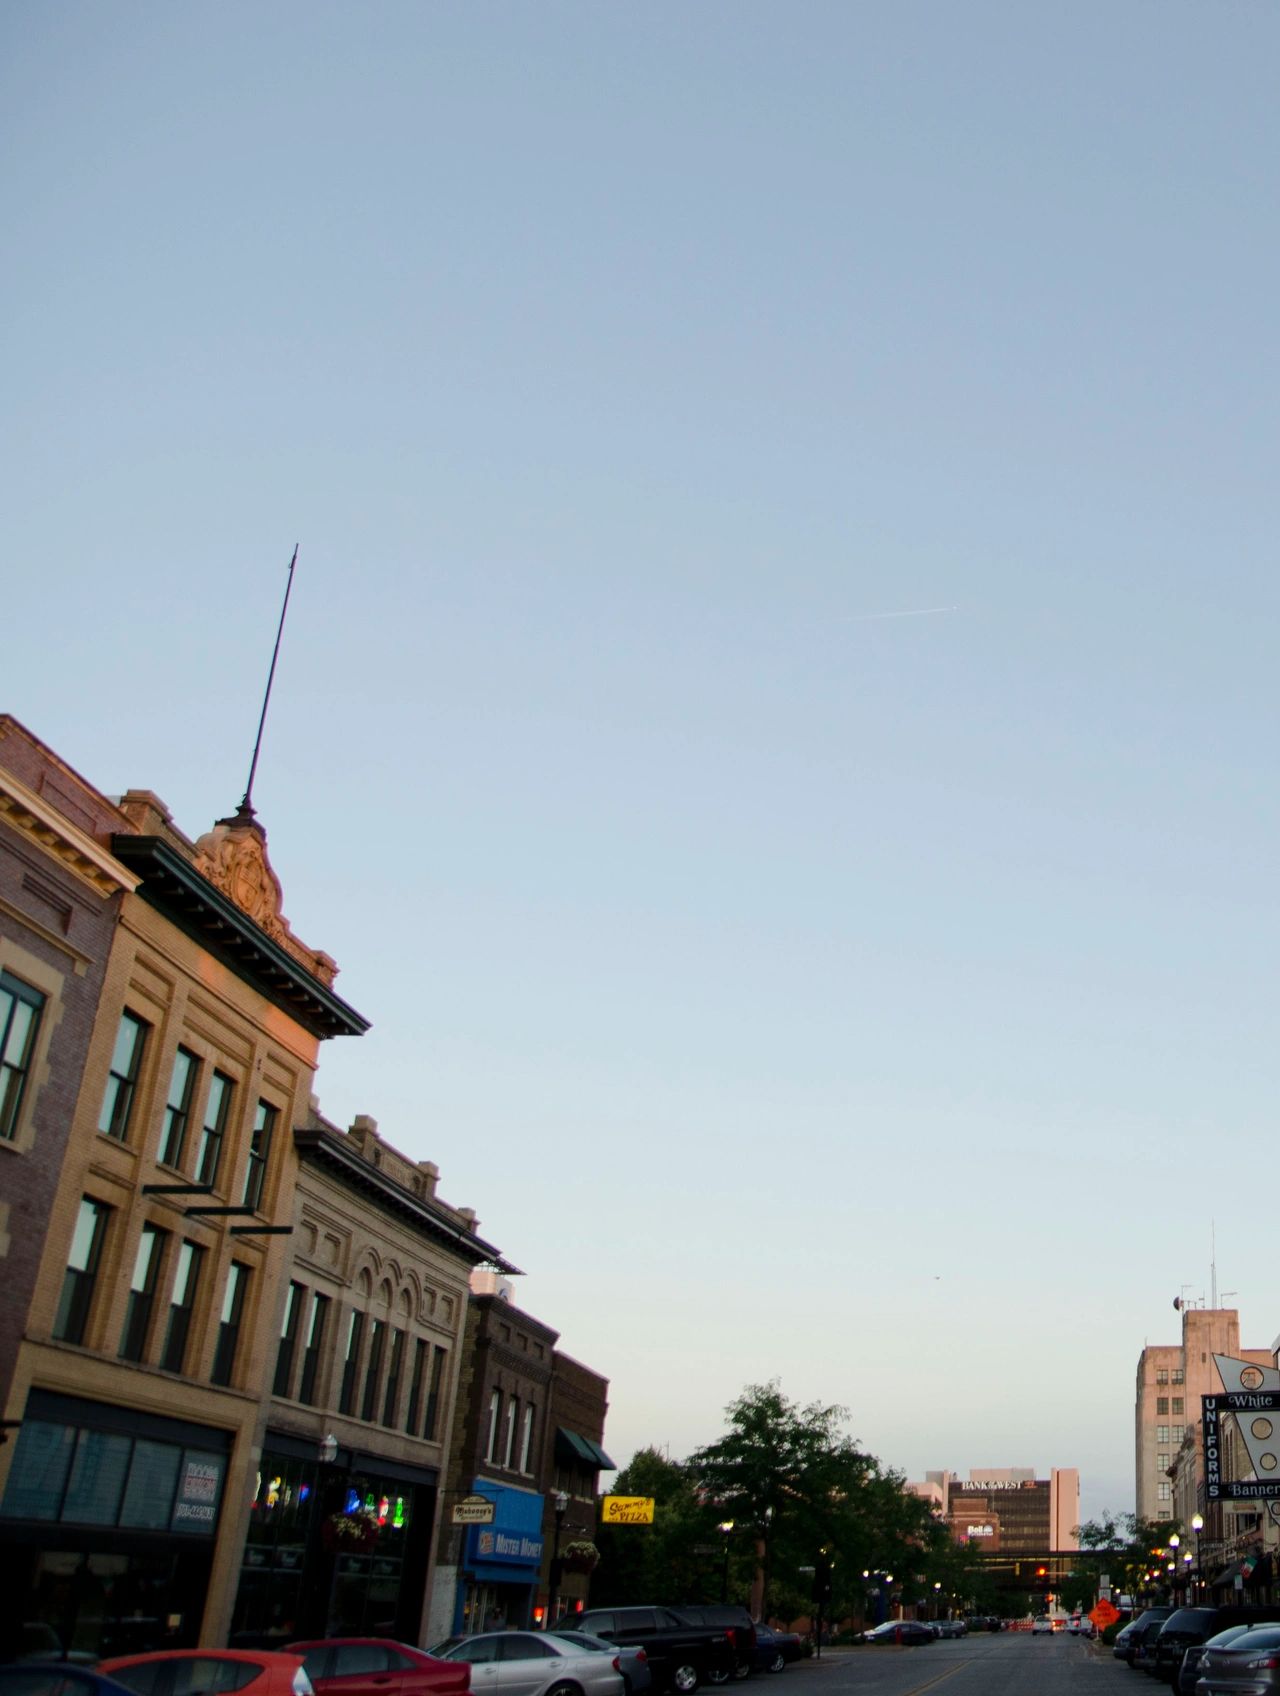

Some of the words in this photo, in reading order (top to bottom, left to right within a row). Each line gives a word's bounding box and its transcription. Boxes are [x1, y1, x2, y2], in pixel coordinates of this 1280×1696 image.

[1229, 1395, 1273, 1407] White
[1206, 1399, 1219, 1497] UNIFORMS
[962, 1481, 988, 1490] BANK
[996, 1480, 1021, 1489] WEST
[1229, 1484, 1280, 1496] Banner
[619, 1512, 649, 1521] PIZZA
